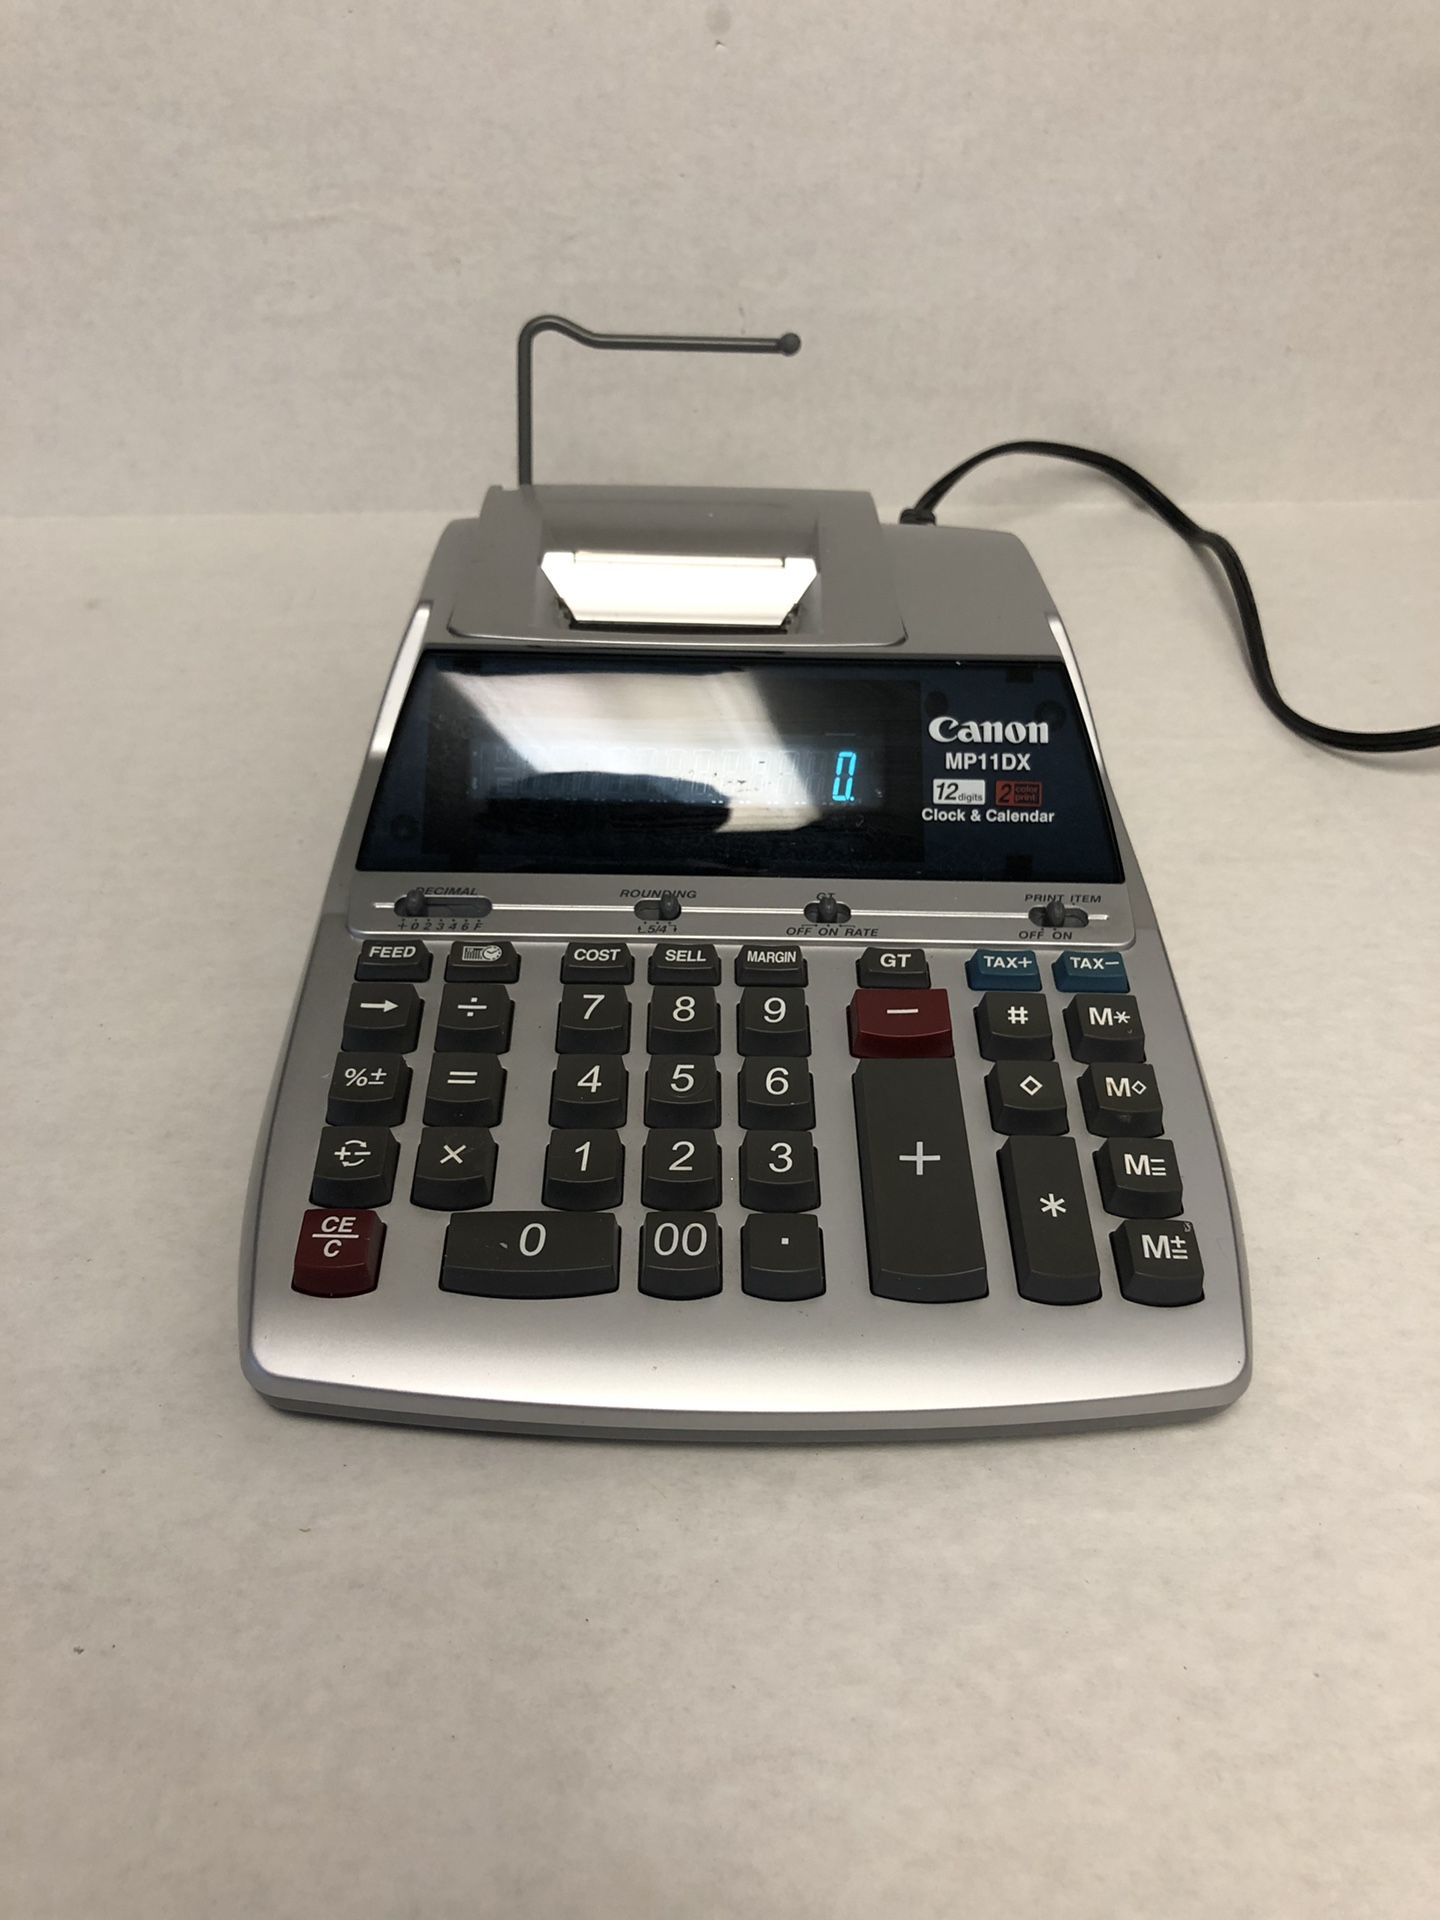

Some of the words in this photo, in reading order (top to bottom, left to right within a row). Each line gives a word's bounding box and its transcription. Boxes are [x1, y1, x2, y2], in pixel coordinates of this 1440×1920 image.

[929, 717, 1049, 744] Canon
[945, 752, 1031, 771] MP11DX
[936, 782, 959, 800] 12
[958, 793, 983, 803] digits
[999, 783, 1012, 803] 2
[921, 808, 966, 822] Clock
[970, 809, 981, 822] &
[985, 809, 1055, 823] Calendar
[1024, 893, 1065, 903] PRINT
[1070, 894, 1102, 904] ITEM
[785, 927, 813, 936] OFF
[818, 928, 839, 937] ON
[844, 928, 879, 937] RATE
[1018, 930, 1045, 940] OFF
[1052, 931, 1073, 940] ON
[368, 945, 417, 959] FEED
[573, 948, 621, 962] COST
[664, 949, 707, 962] SELL
[746, 950, 797, 964] MARGIN
[879, 953, 912, 968] GT
[983, 955, 1033, 969] TAX+
[582, 993, 605, 1020] 7
[672, 996, 696, 1022] 8
[763, 997, 787, 1023] 9
[576, 1064, 602, 1093] 4
[670, 1064, 695, 1092] 5
[765, 1067, 789, 1095] 6
[574, 1141, 591, 1172] 1
[668, 1141, 695, 1171] 2
[768, 1142, 793, 1173] 3
[320, 1215, 356, 1233] CE
[323, 1238, 342, 1258] C
[518, 1222, 547, 1257] 0
[653, 1222, 708, 1257] 00
